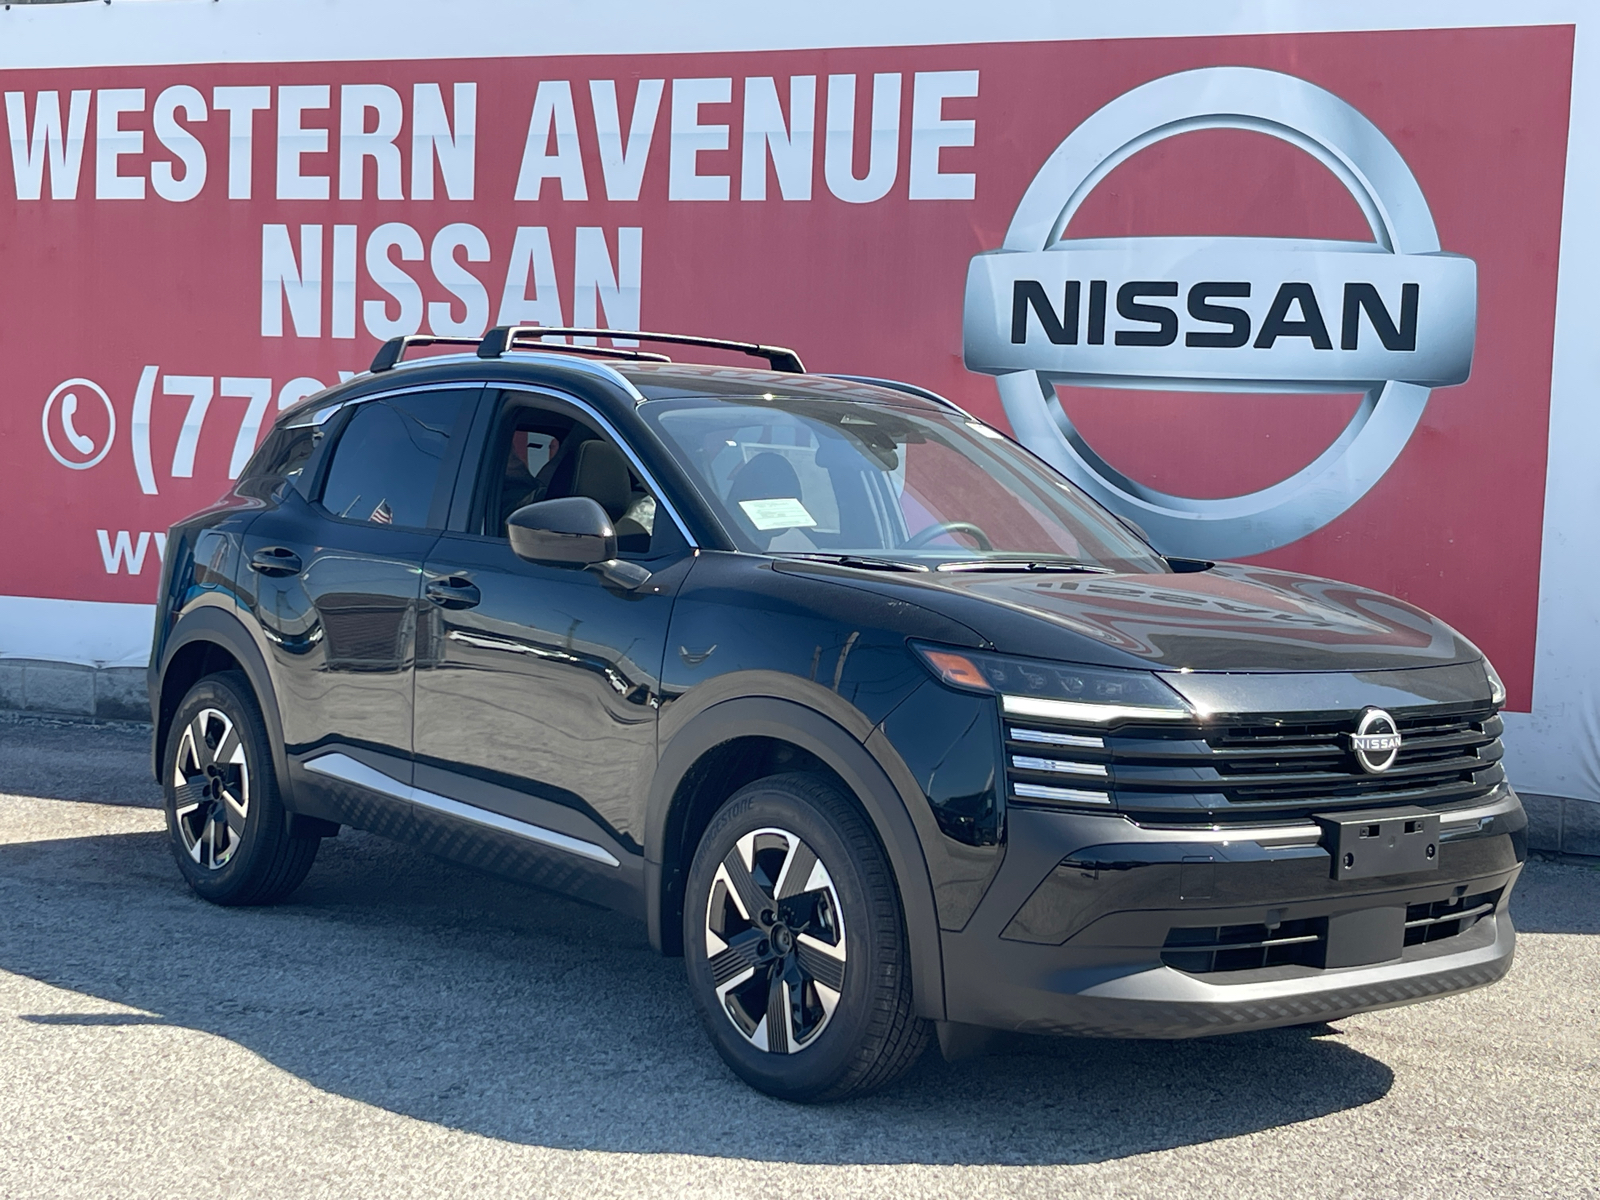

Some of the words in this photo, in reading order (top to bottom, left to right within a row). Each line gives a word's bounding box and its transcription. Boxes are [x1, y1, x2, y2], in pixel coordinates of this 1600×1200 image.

[5, 82, 477, 202] WESTERN
[514, 70, 980, 206] AVENUE
[261, 222, 643, 348] NISSAN
[1012, 280, 1420, 352] NISSAN
[1354, 737, 1402, 749] NISSAN
